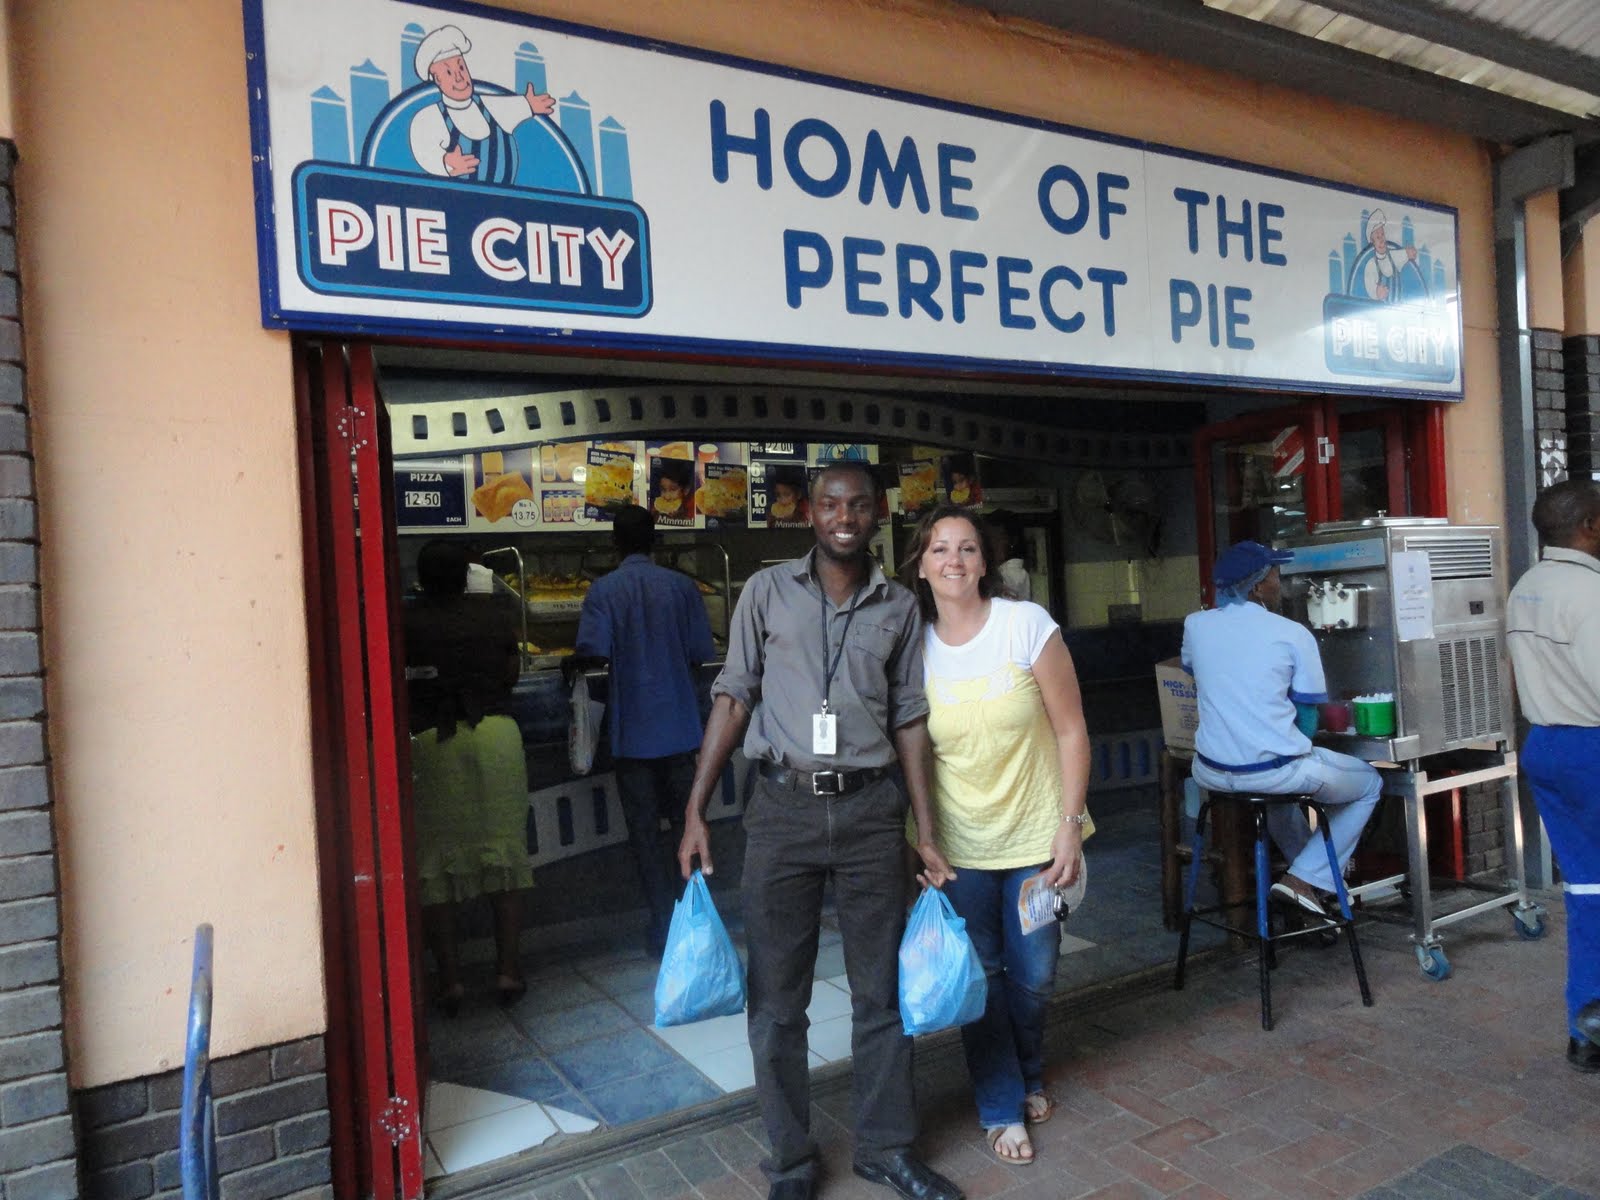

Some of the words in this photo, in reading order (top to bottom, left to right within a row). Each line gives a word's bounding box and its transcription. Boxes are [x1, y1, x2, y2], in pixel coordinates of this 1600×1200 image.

[709, 98, 980, 222] HOME
[1037, 164, 1130, 241] OF
[1173, 186, 1288, 267] THE
[316, 197, 450, 276] PIE
[471, 216, 636, 291] CITY
[783, 228, 1128, 338] PERFECT
[1169, 278, 1255, 351] PIE
[1331, 316, 1380, 359] PIE
[1386, 325, 1448, 366] CITY
[750, 461, 761, 477] 6
[410, 473, 443, 482] PIZZA
[405, 492, 440, 506] 12.50
[752, 492, 767, 507] 10
[514, 511, 536, 520] 13.75
[1171, 688, 1198, 699] TISSU
